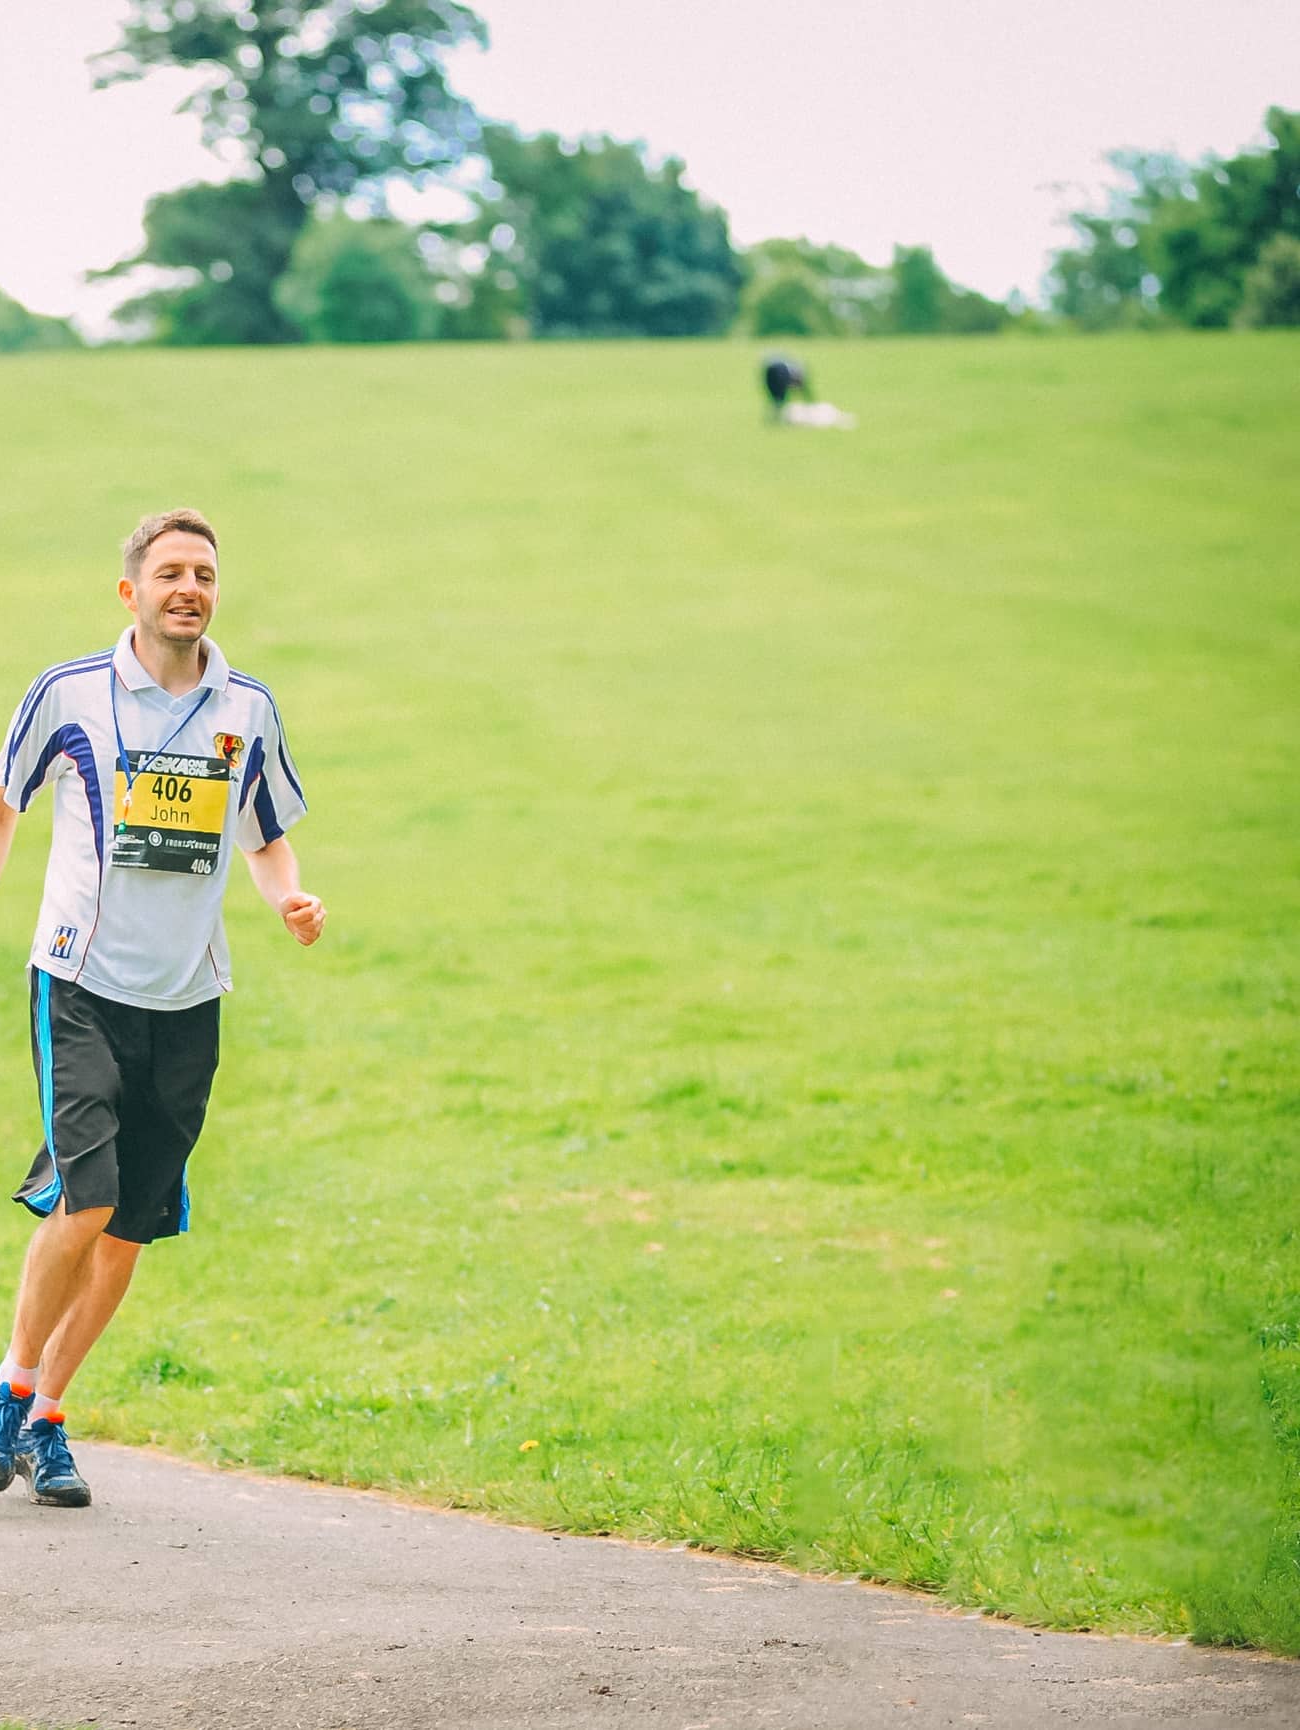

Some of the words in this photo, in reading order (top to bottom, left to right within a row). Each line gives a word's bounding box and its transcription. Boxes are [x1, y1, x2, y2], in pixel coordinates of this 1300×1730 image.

[152, 775, 192, 803] 406
[150, 805, 190, 824] John
[190, 858, 212, 875] 406
